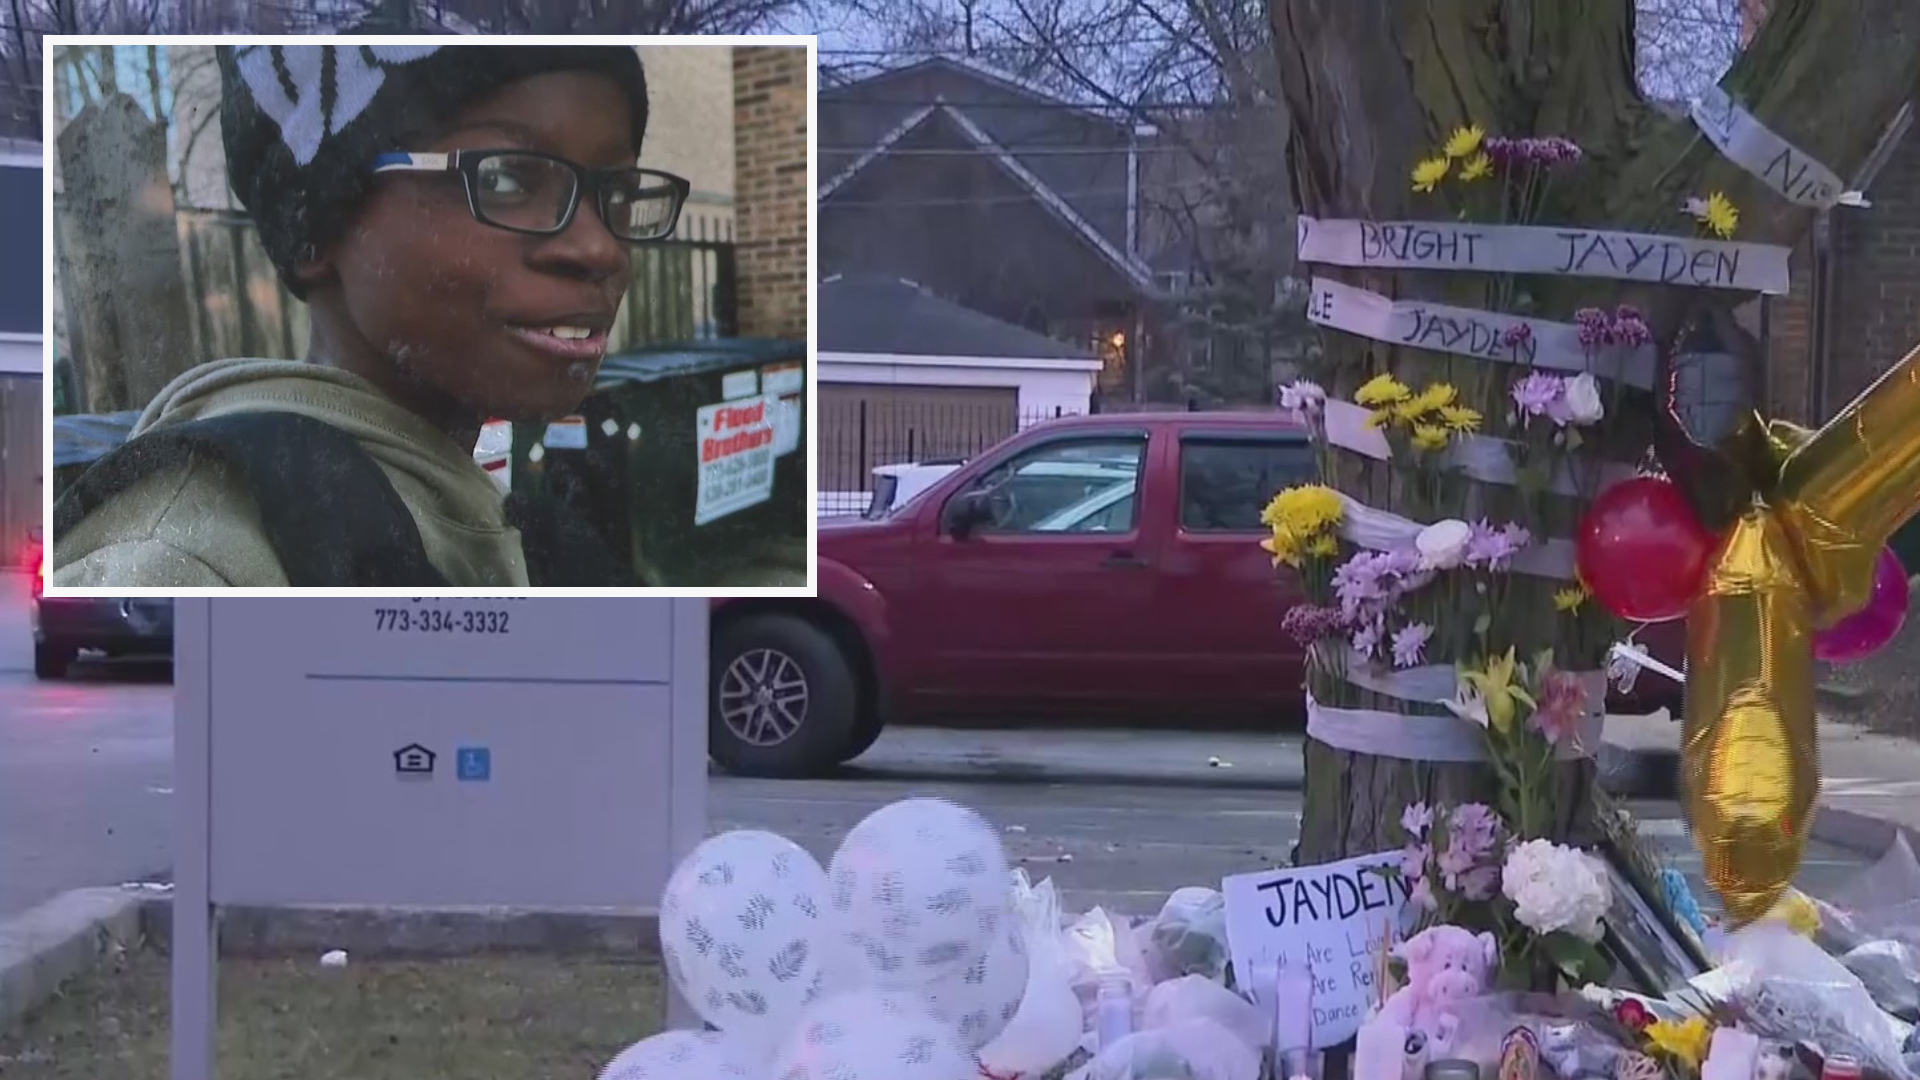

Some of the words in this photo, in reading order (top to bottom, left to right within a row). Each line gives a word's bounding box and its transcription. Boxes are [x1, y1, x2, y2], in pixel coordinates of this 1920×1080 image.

[1360, 222, 1483, 264] BRIGHT
[702, 428, 773, 463] Brothers
[375, 608, 510, 634] 773-334-3332
[1256, 861, 1413, 928] JAYDEN
[1313, 1003, 1359, 1028] Dance
